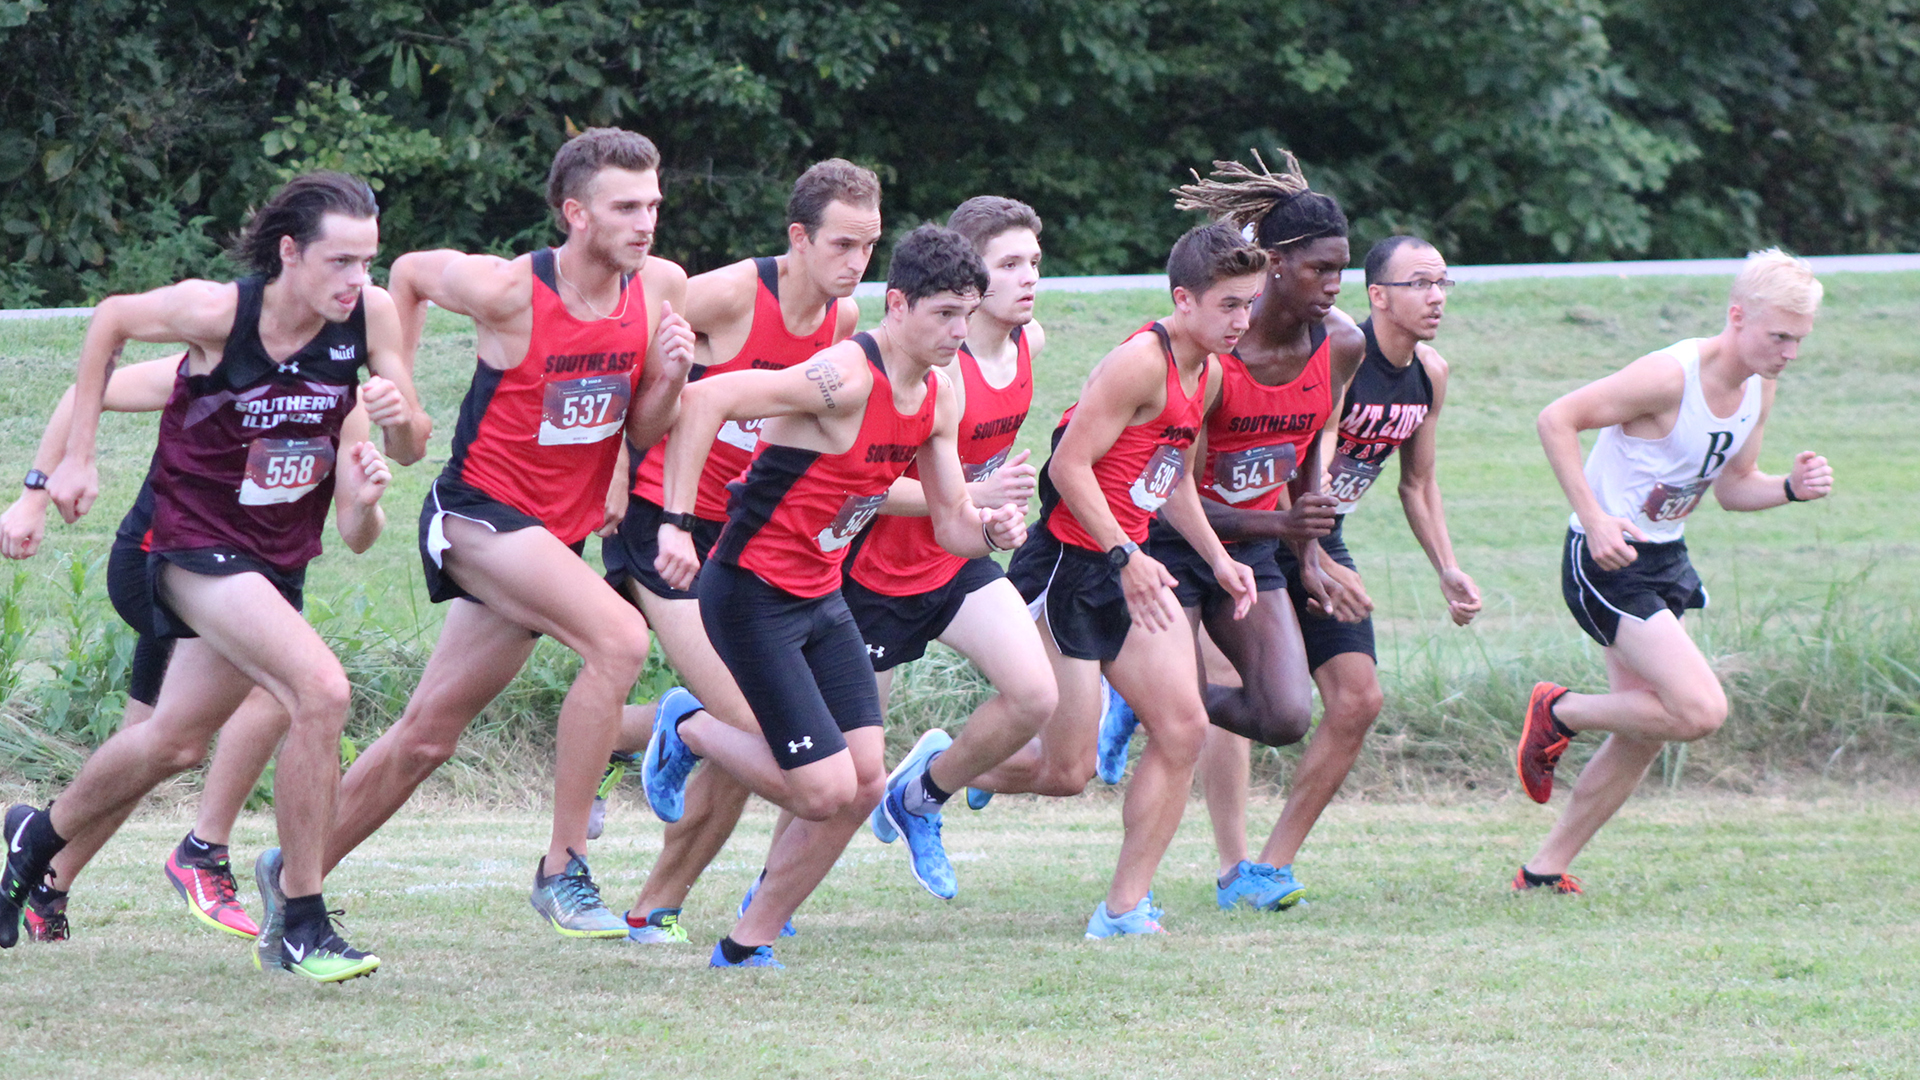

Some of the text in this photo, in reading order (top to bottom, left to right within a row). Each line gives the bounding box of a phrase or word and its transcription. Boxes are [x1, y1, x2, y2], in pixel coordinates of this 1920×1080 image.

[329, 345, 355, 360] VALLEY
[545, 352, 637, 373] SOUTHEAST
[805, 367, 836, 409] UNITED
[234, 395, 340, 415] SOUTHERN
[562, 393, 612, 427] 537
[241, 412, 323, 429] ILLINOIS
[1229, 413, 1316, 433] SOUTHEAST
[1697, 431, 1734, 478] B
[265, 455, 316, 486] 558
[1150, 462, 1177, 495] 539
[1232, 458, 1275, 490] 541
[1330, 472, 1371, 500] 563
[1656, 494, 1697, 520] 527
